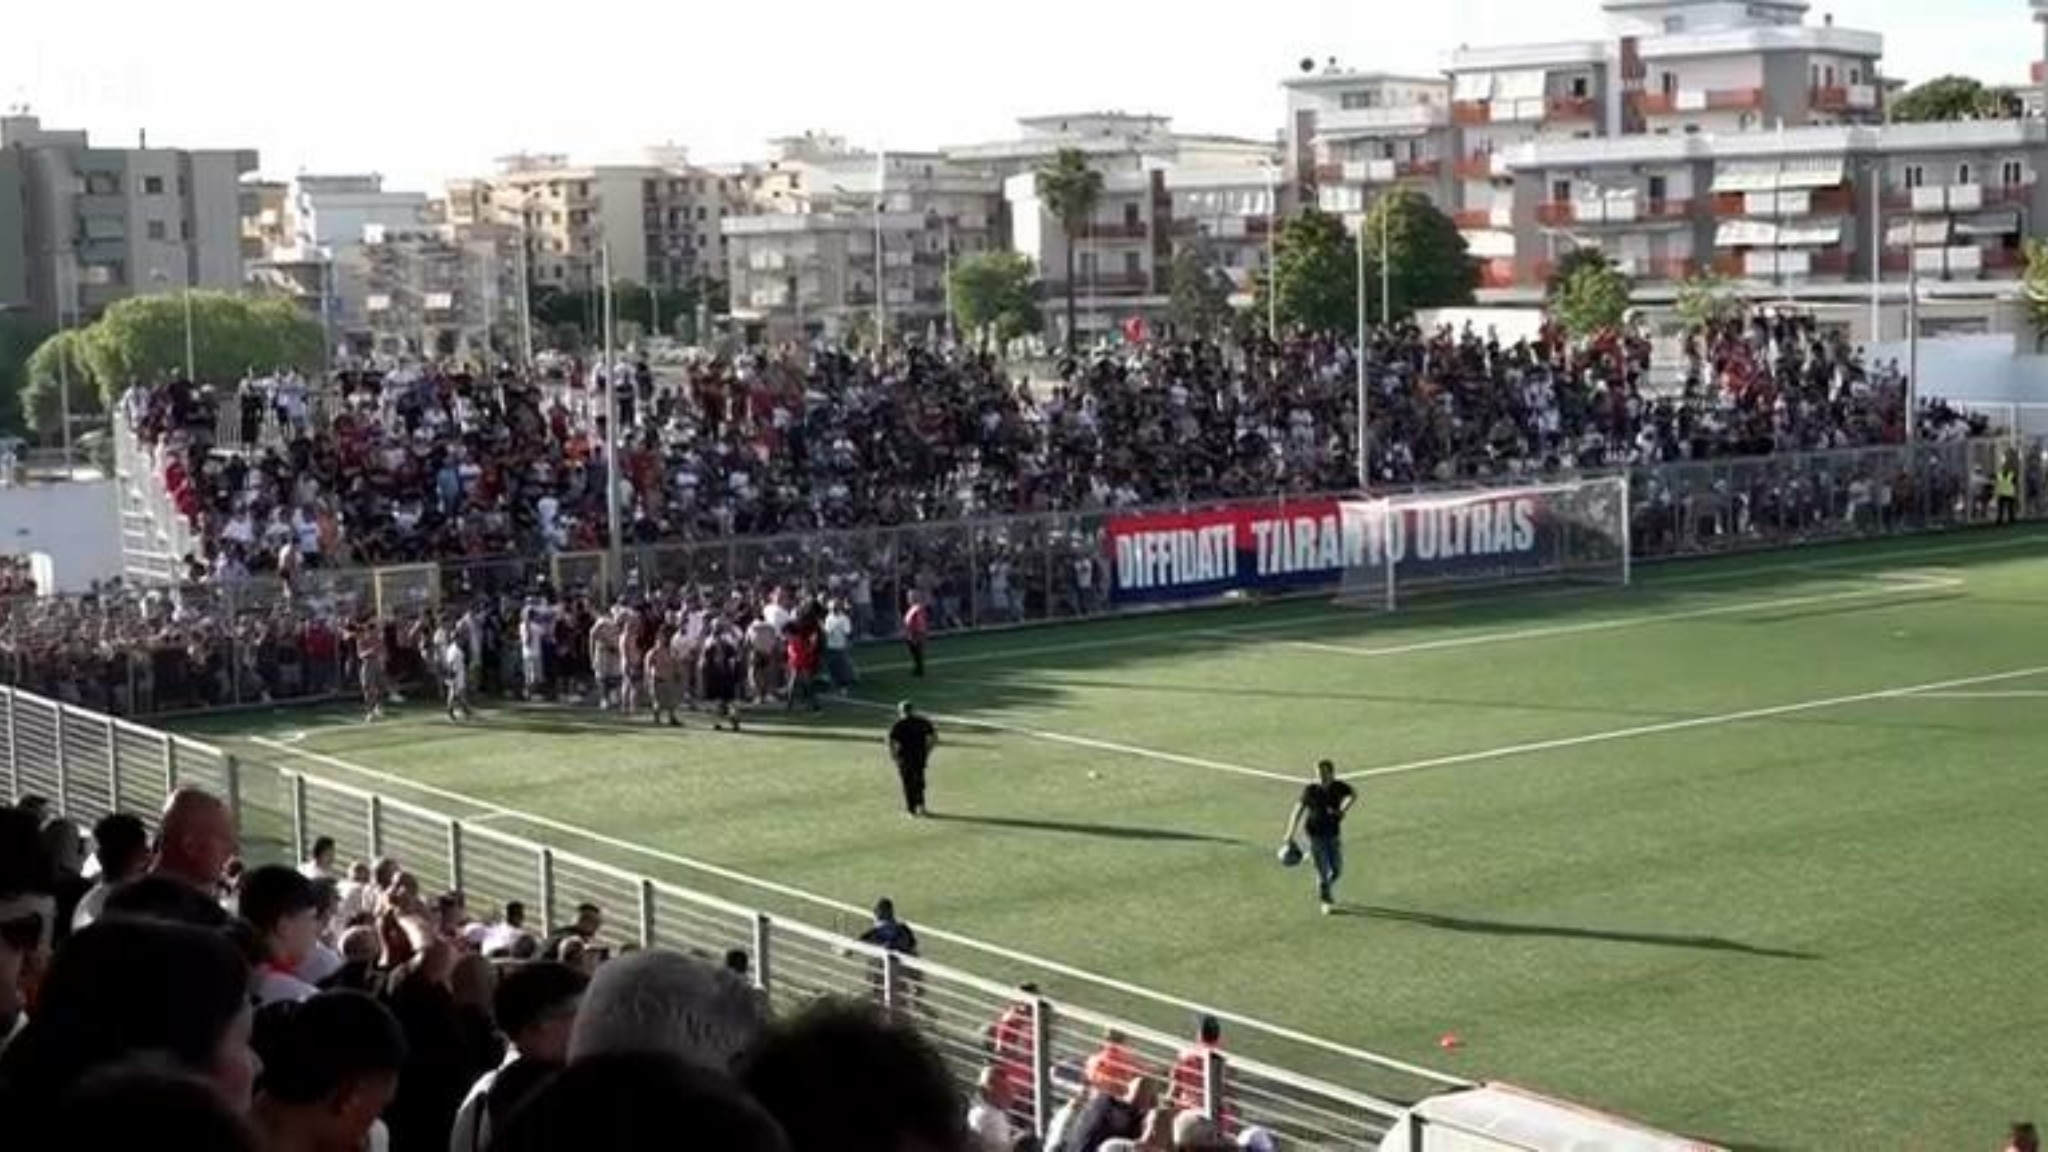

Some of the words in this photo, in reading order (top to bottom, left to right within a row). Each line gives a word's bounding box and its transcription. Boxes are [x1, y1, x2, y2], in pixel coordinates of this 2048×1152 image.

[1117, 524, 1236, 588] DIFFIDATI
[1250, 508, 1405, 576] TARANTO
[1417, 499, 1534, 560] ULTRAS
